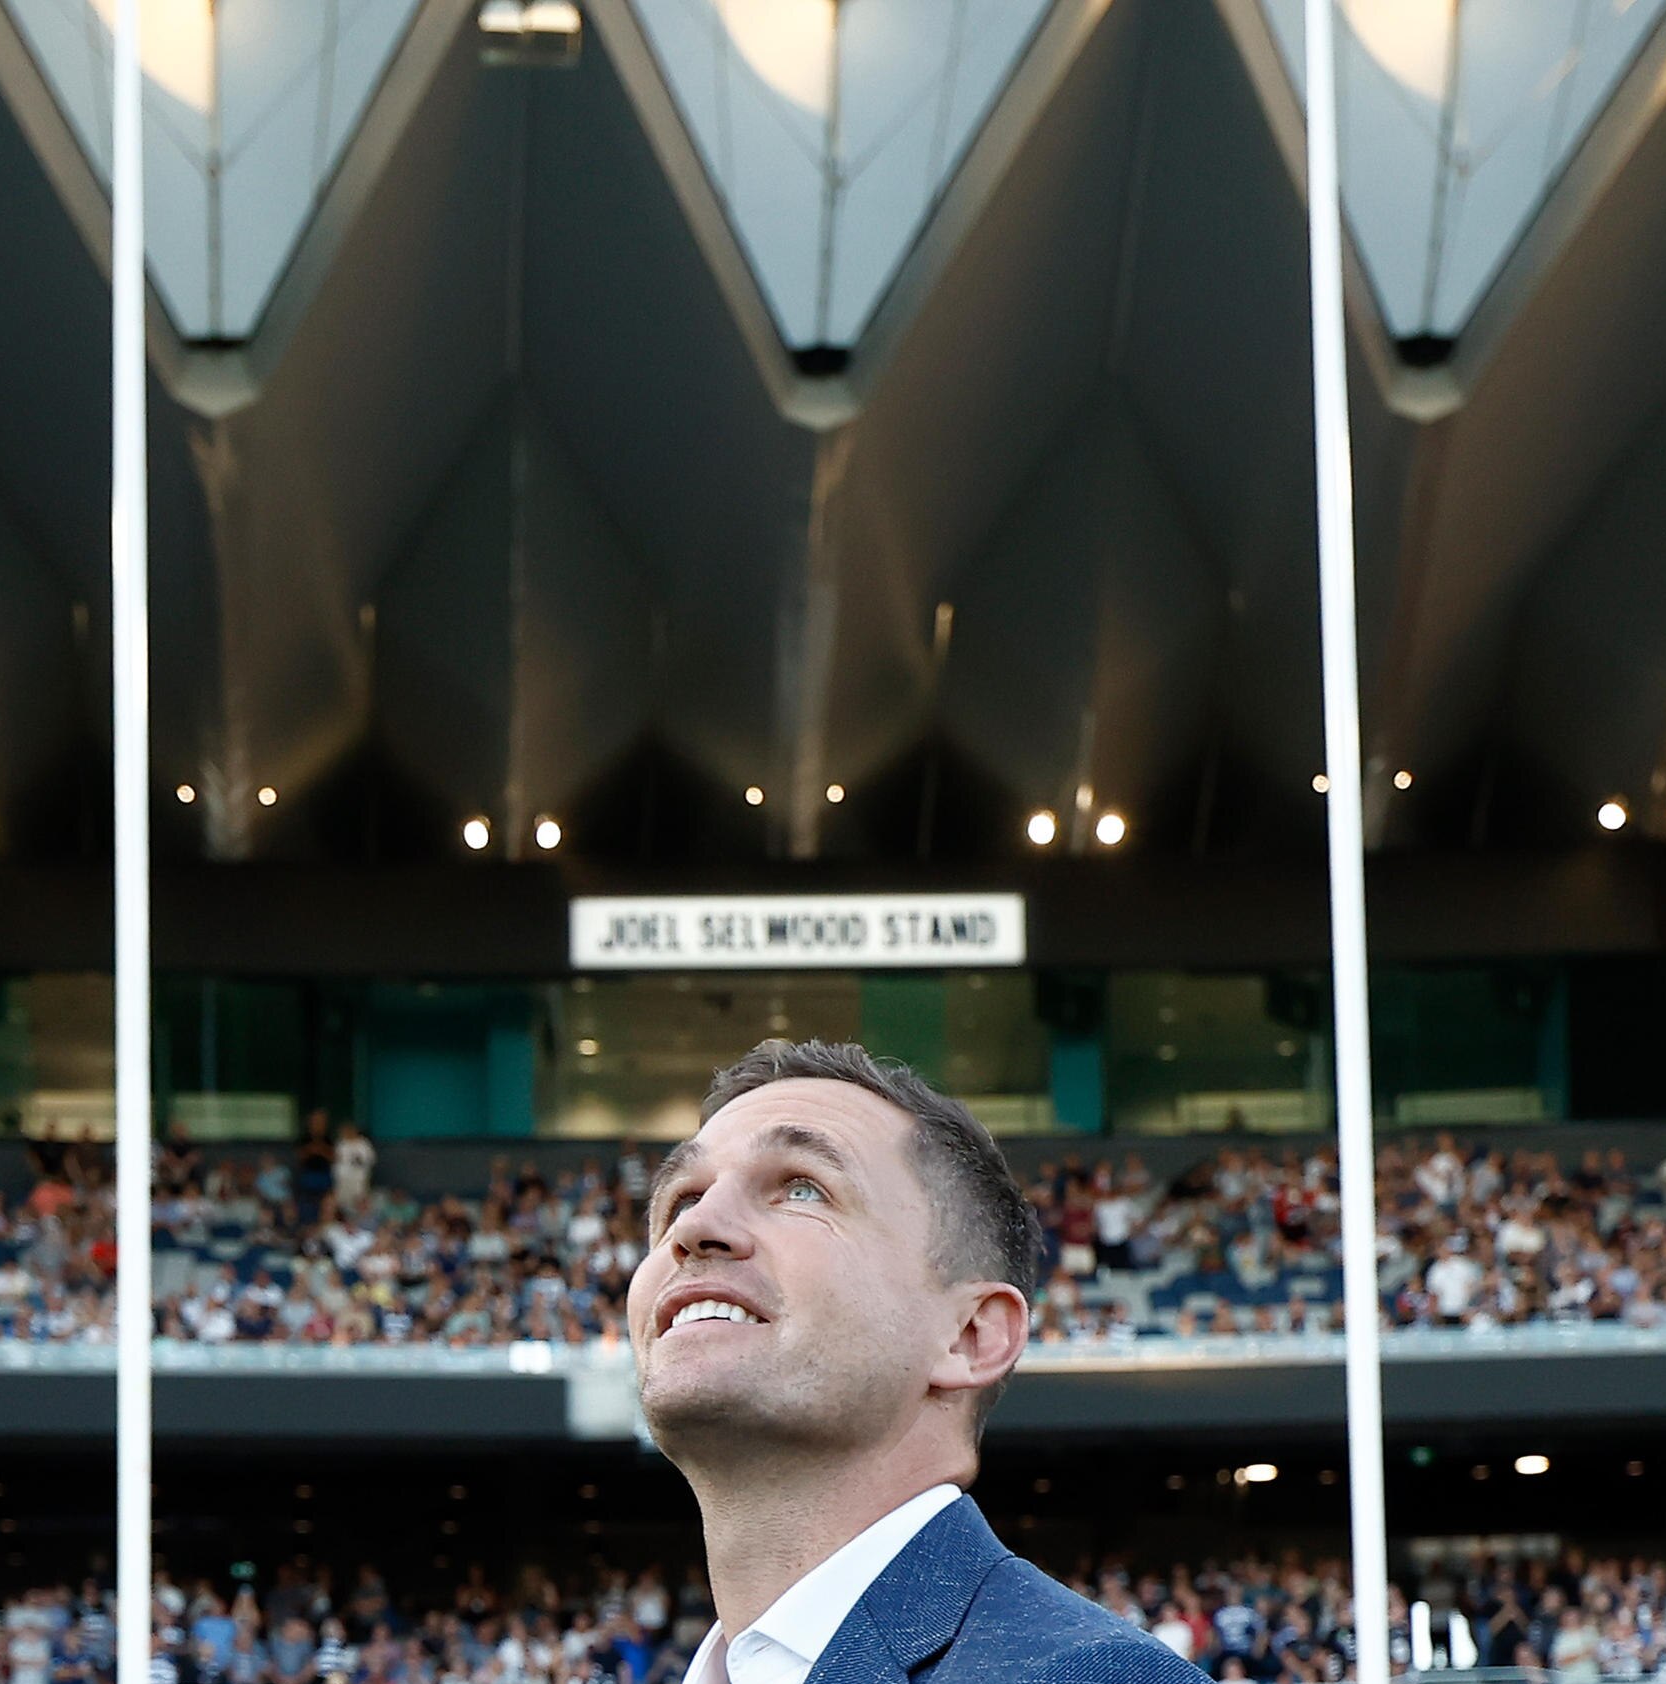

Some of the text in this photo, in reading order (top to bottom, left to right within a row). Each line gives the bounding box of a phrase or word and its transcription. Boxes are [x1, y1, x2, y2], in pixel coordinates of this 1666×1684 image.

[599, 910, 998, 951] JOEL SELWOOD STAND
